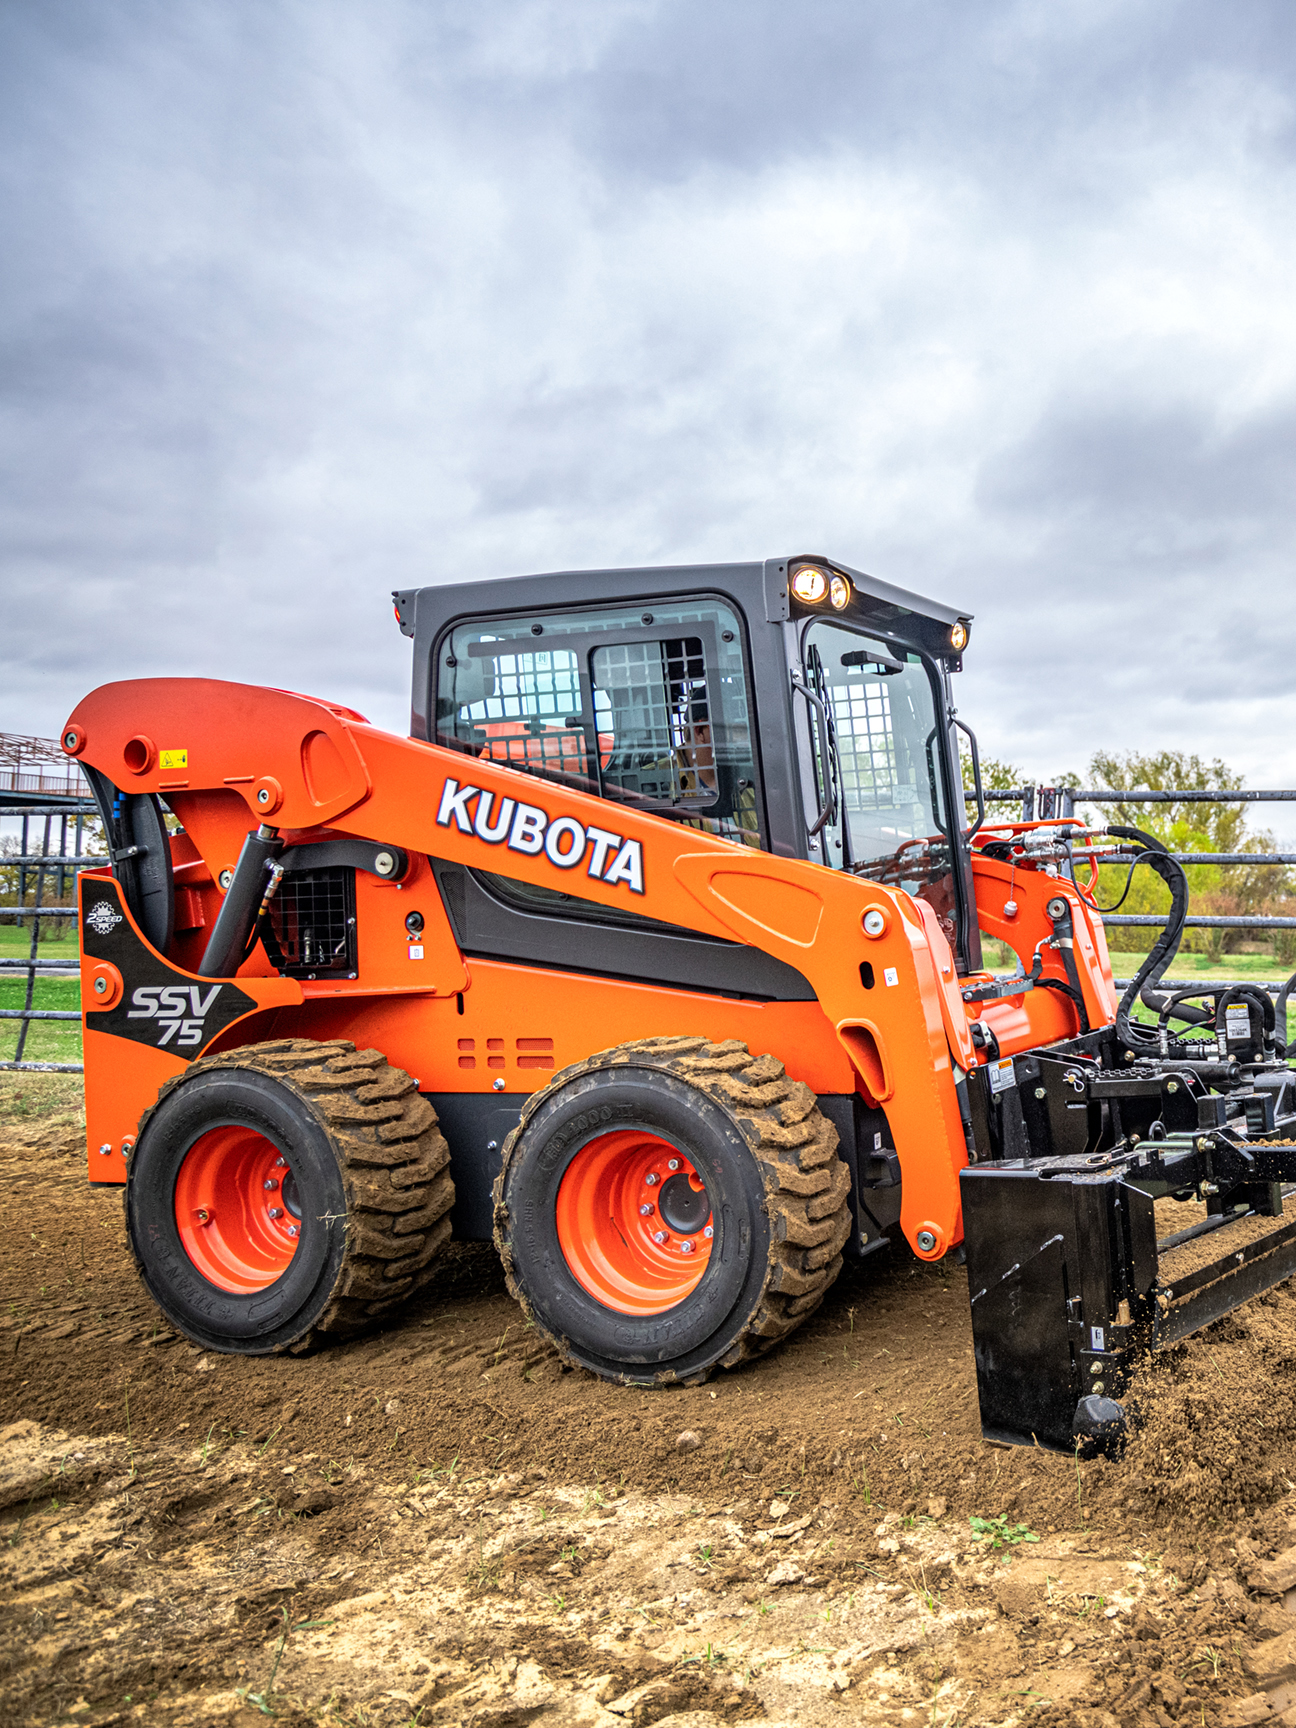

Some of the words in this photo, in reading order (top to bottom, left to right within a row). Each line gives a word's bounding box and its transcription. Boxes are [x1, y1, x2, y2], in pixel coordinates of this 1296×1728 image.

[436, 778, 644, 894] KUBOTA
[127, 985, 223, 1018] SSV
[157, 1019, 205, 1046] 75
